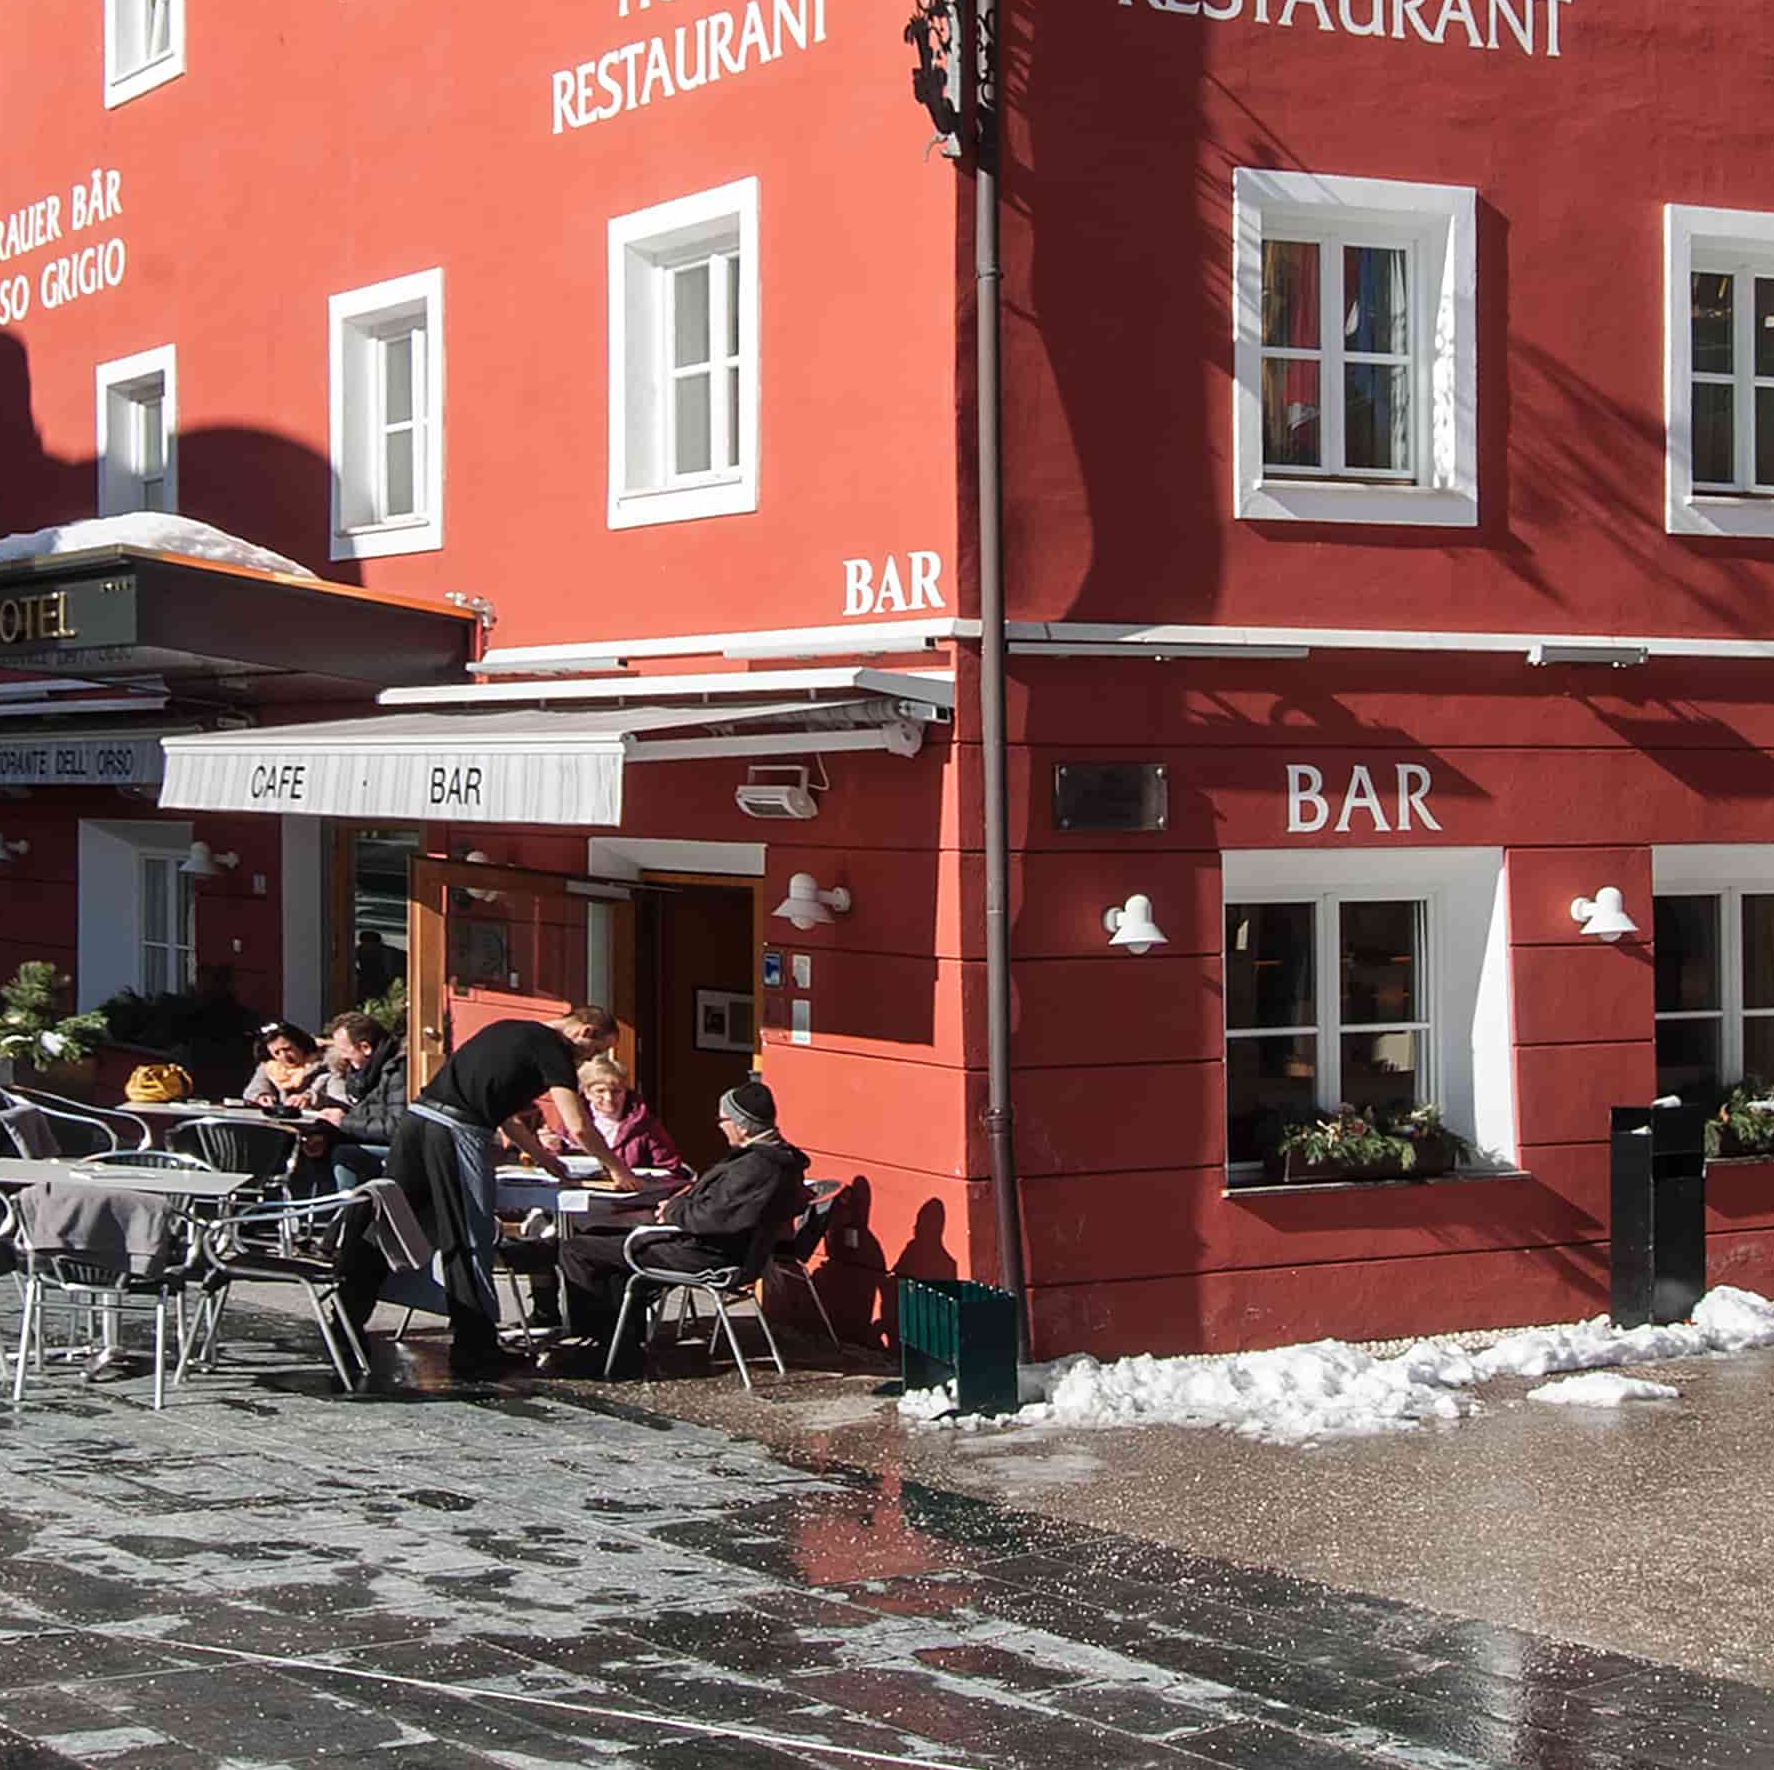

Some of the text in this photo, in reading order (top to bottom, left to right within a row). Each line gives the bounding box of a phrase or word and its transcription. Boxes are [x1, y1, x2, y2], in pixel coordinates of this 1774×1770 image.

[72, 168, 123, 230] BÄR
[40, 238, 125, 309] GRIGIO
[842, 550, 945, 616] BAR
[98, 748, 133, 775] ORSO
[251, 765, 482, 806] CAFE BAR
[1286, 762, 1443, 833] BAR
